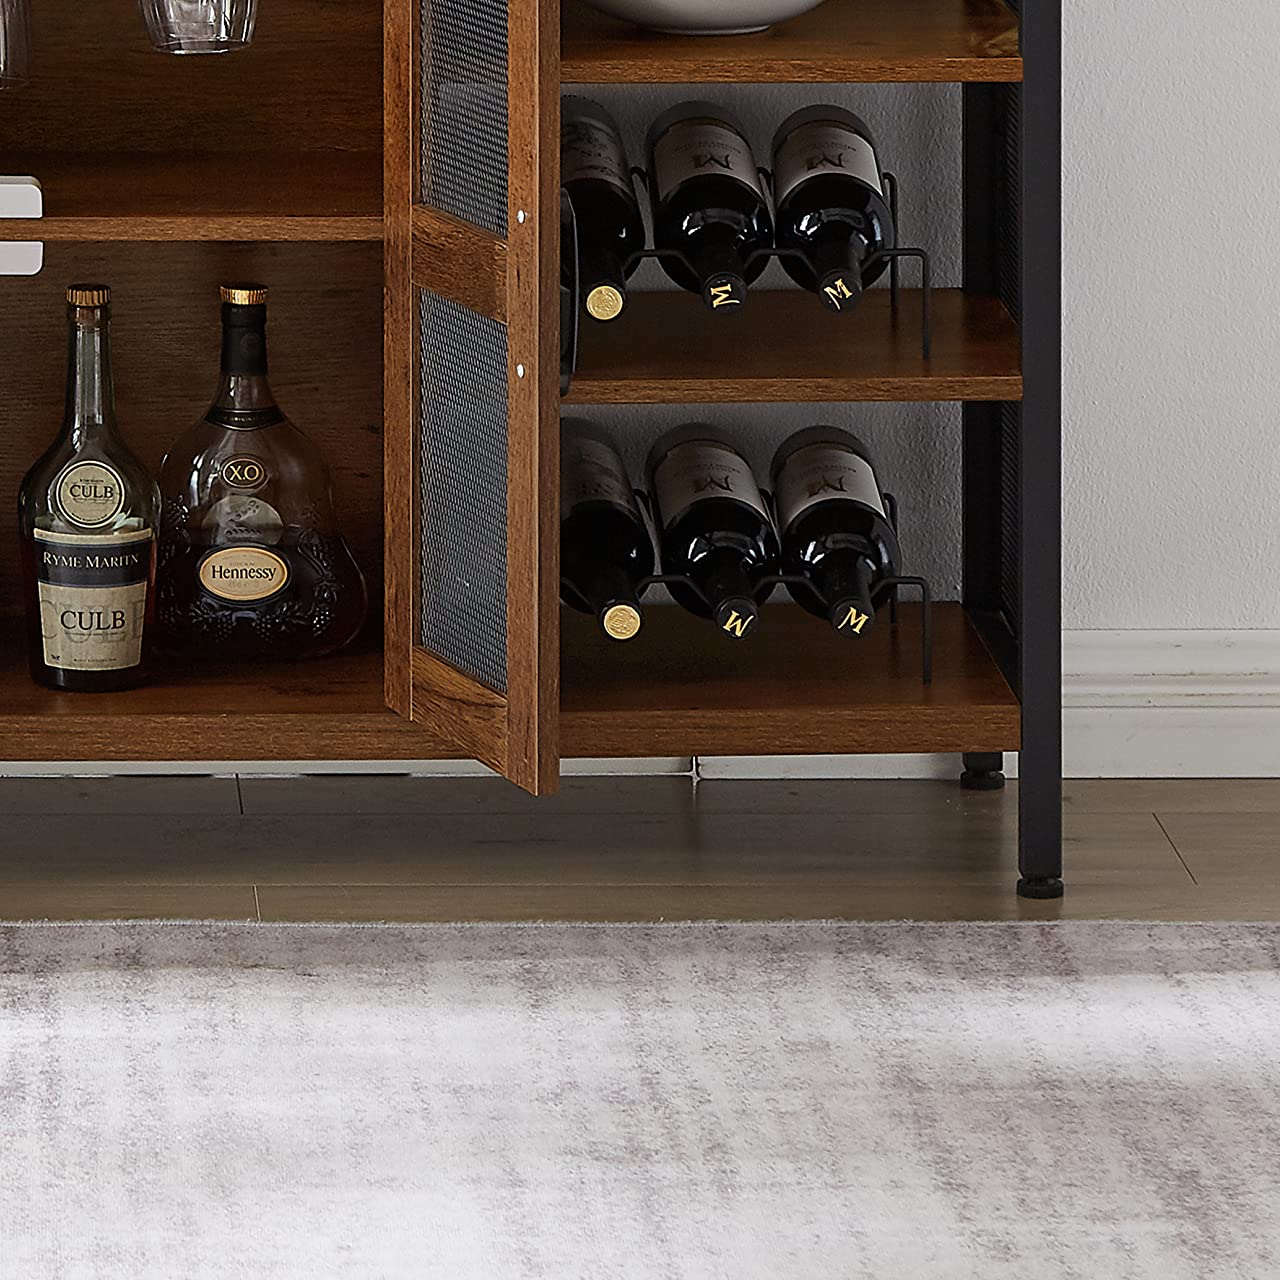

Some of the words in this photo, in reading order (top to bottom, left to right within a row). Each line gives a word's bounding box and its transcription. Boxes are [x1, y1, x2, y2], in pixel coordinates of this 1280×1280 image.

[70, 484, 114, 499] CULB
[43, 551, 82, 568] RYME
[211, 565, 277, 582] Hennessy
[60, 610, 126, 631] CULB
